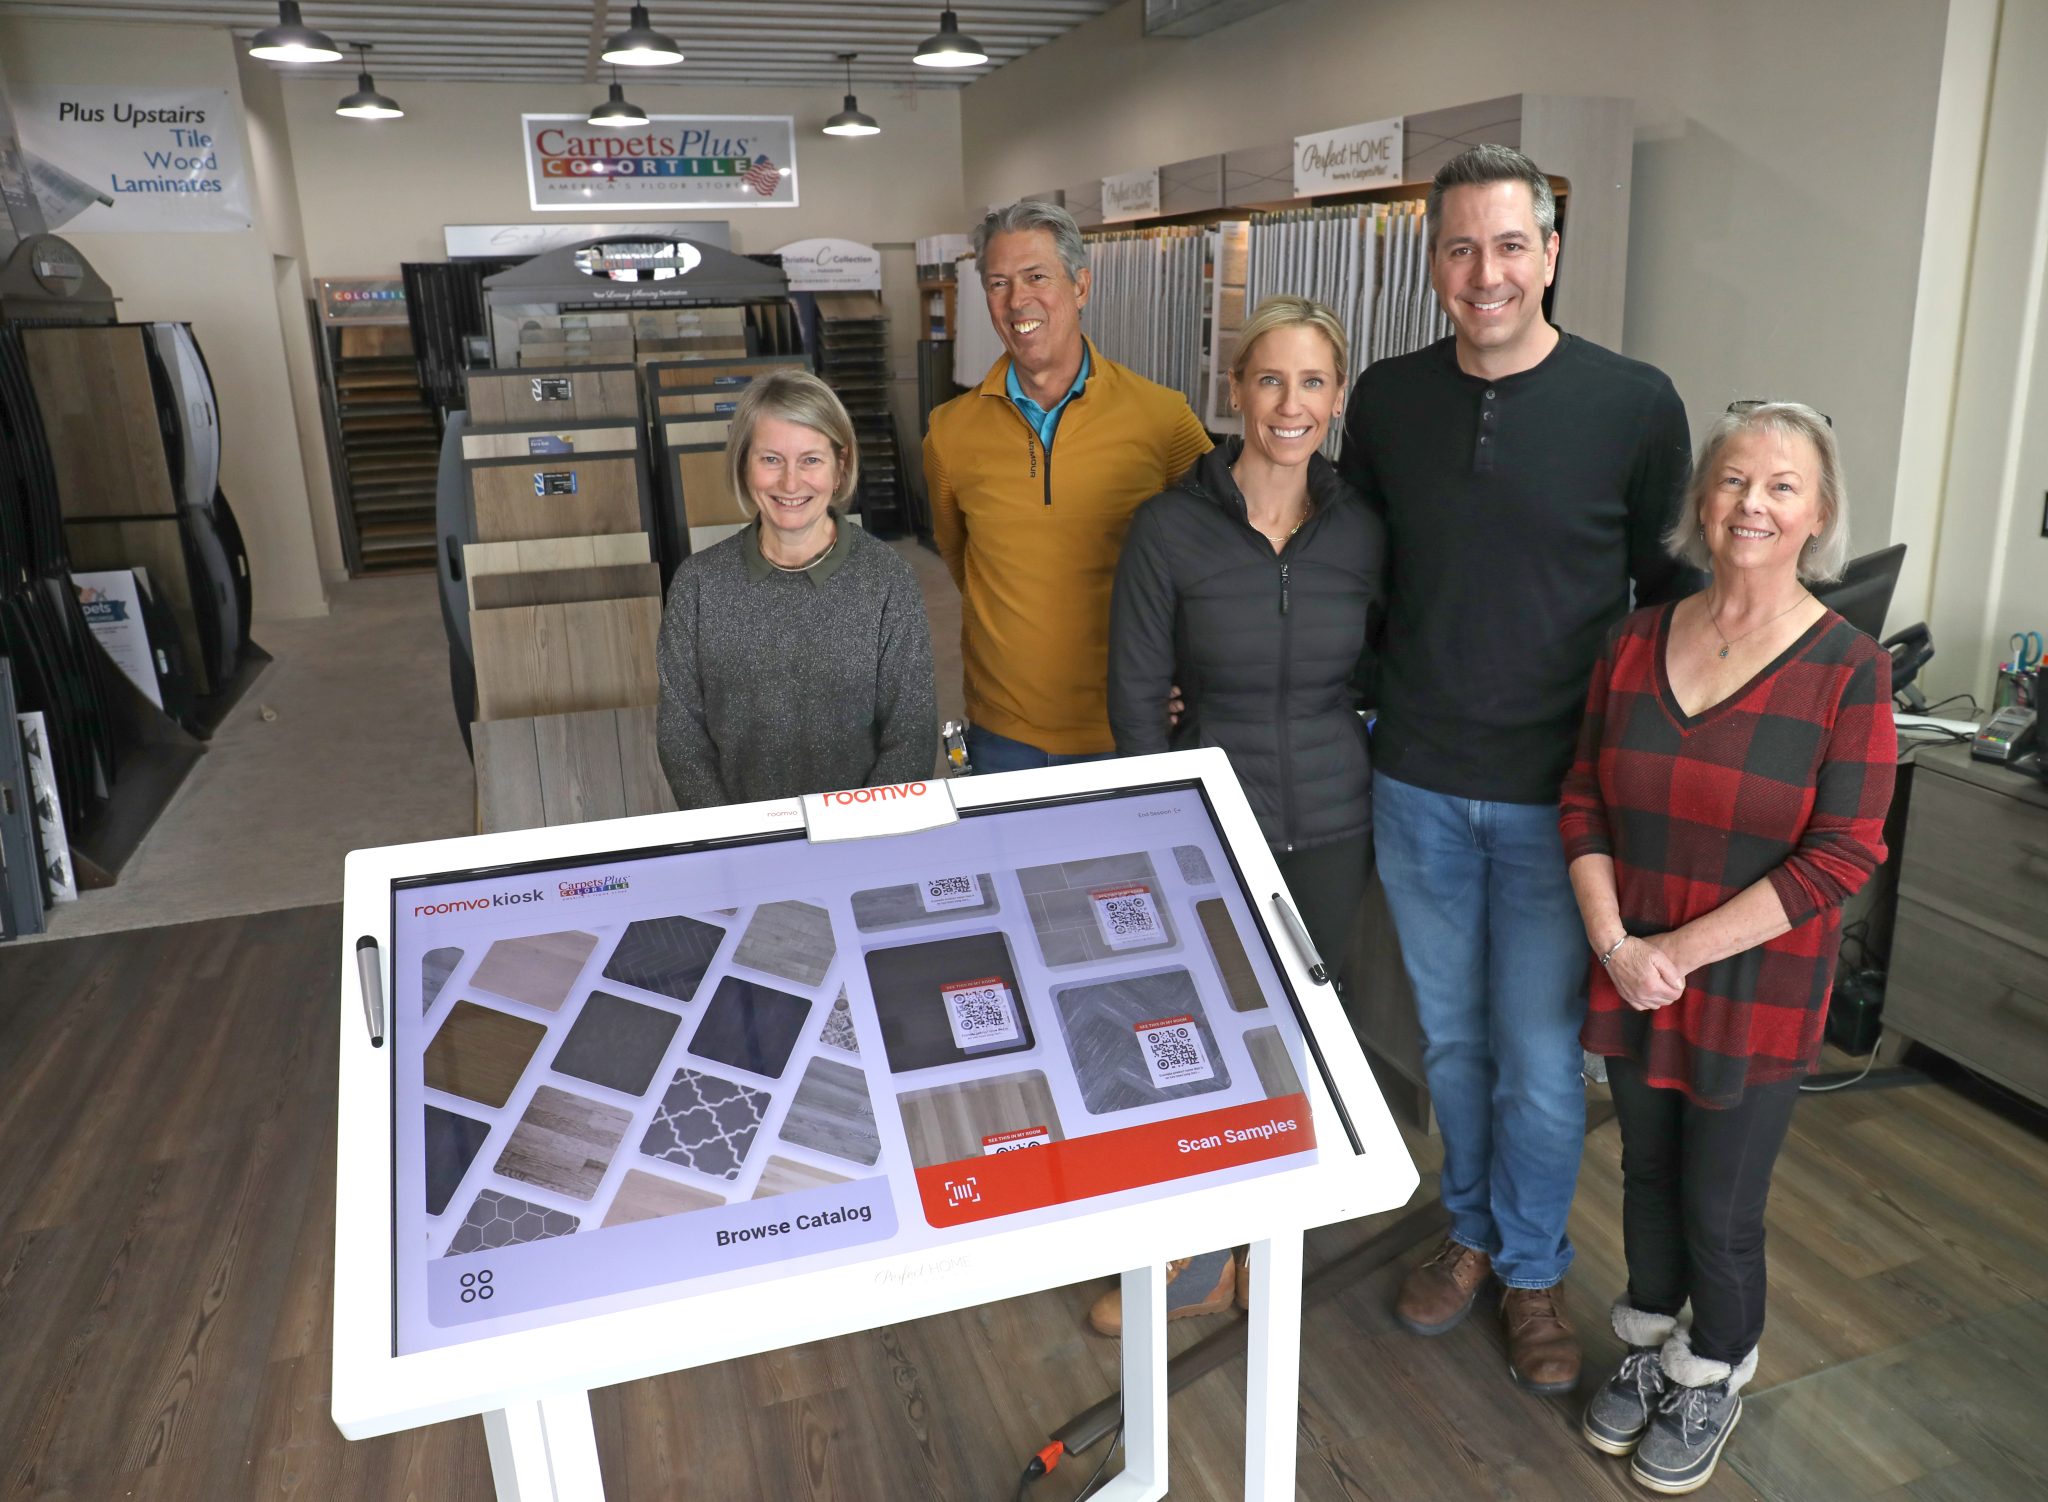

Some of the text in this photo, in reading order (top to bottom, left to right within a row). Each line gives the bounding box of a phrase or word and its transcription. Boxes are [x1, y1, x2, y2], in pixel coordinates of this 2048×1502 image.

[59, 102, 206, 128] Plus Upstairs
[170, 128, 213, 149] Tile
[144, 150, 218, 170] Wood
[545, 159, 749, 175] COLORTILE
[1303, 137, 1391, 177] Perfect HOME
[111, 173, 223, 193] Laminates
[334, 292, 405, 300] COLORTIL
[82, 602, 112, 616] pets
[823, 782, 927, 807] roomvo
[415, 898, 490, 917] roomvo
[492, 889, 545, 907] kiosk
[1177, 1119, 1298, 1154] Scan Samples
[716, 1205, 872, 1247] Browse Catalog
